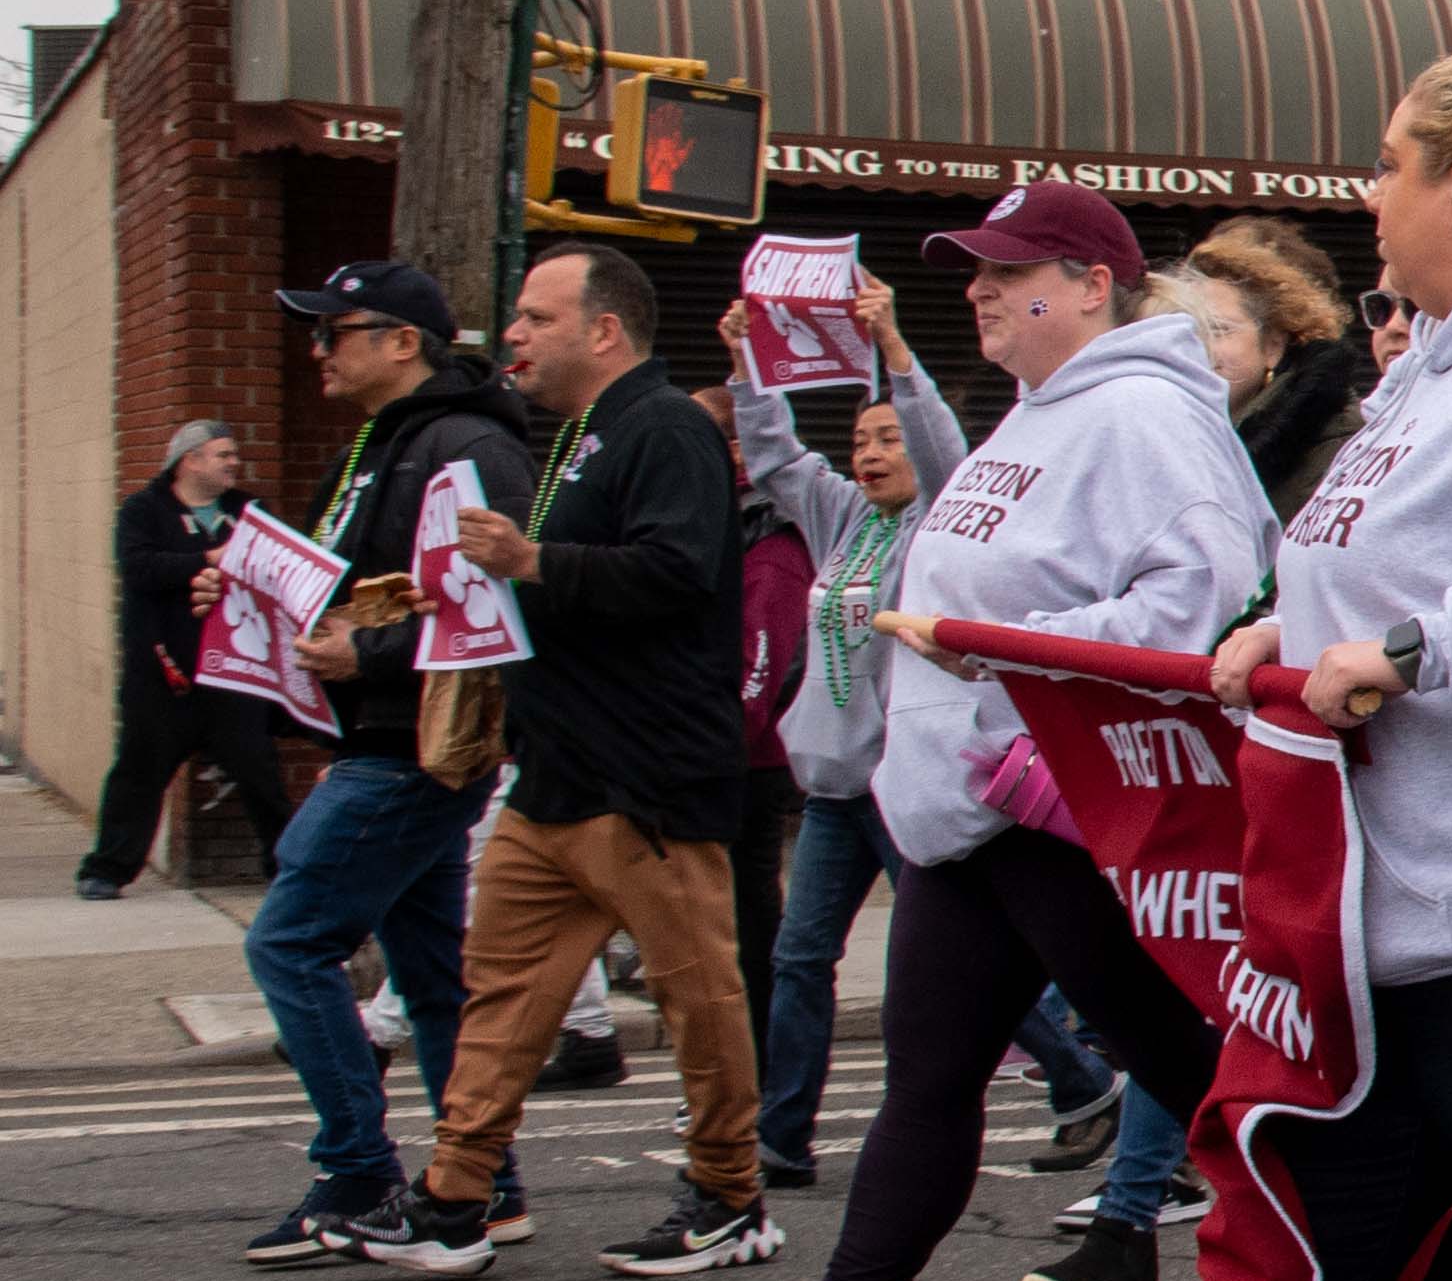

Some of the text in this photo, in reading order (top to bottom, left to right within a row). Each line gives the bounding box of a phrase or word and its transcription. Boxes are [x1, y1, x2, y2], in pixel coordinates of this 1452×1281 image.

[896, 158, 937, 176] TO
[940, 161, 999, 180] THE
[1011, 159, 1235, 196] FASHION
